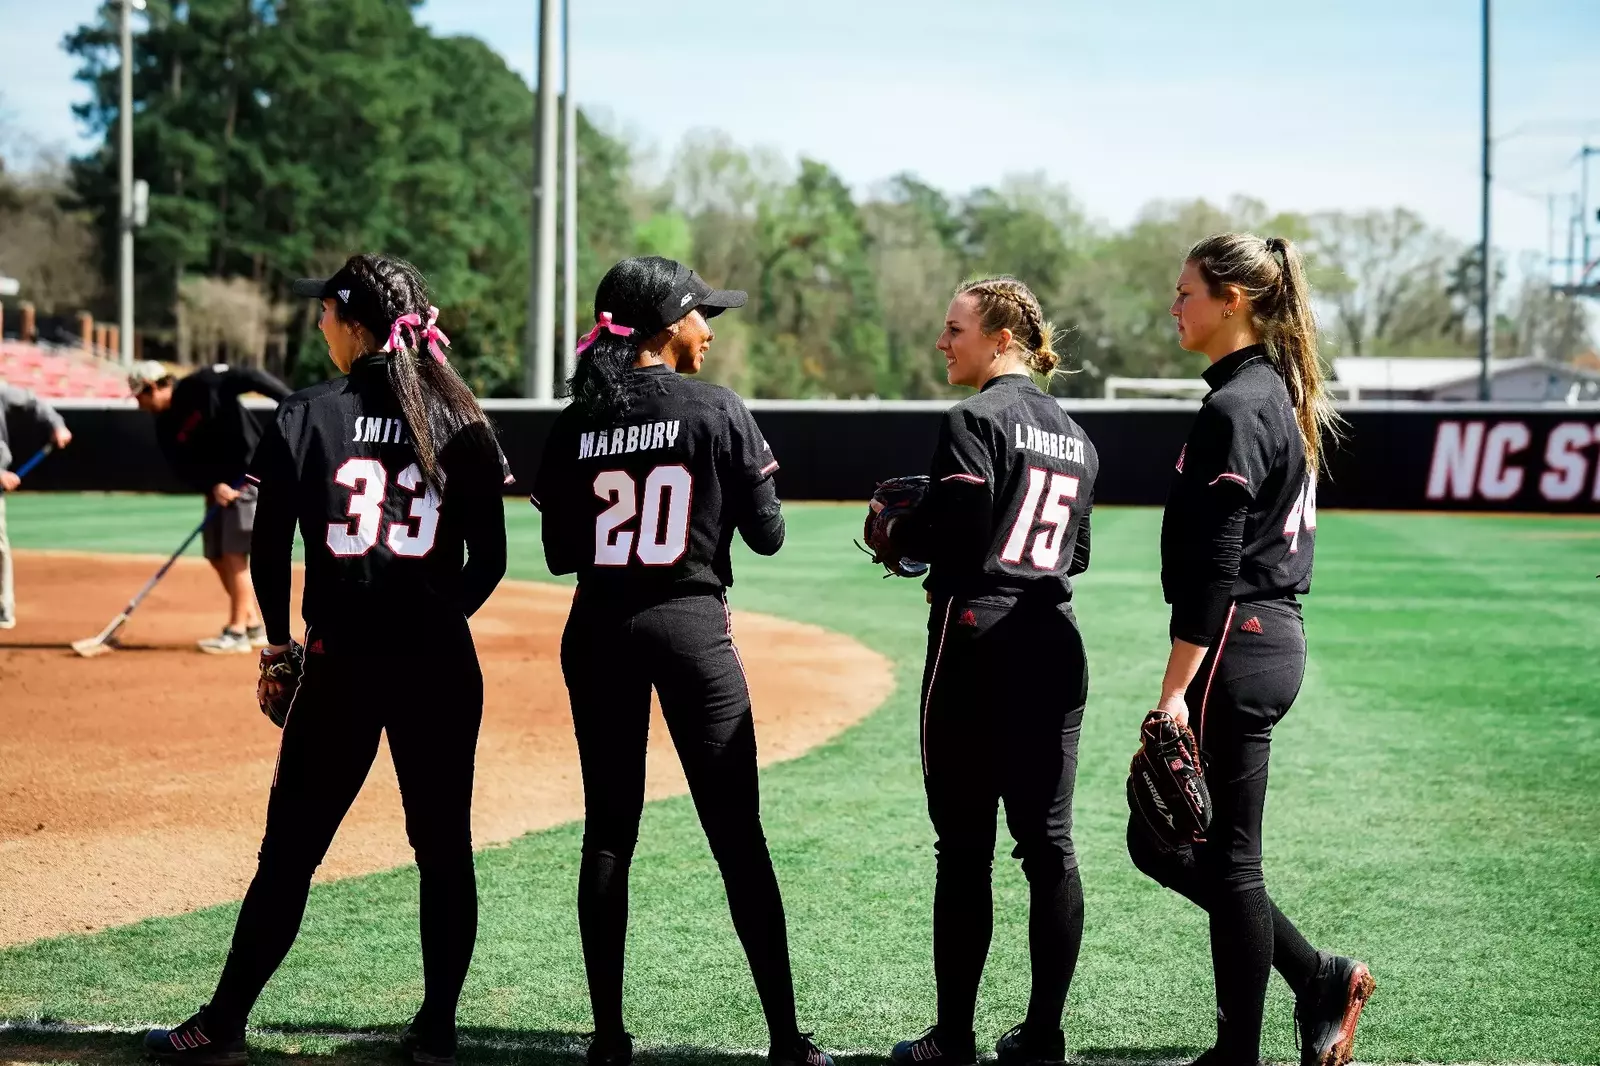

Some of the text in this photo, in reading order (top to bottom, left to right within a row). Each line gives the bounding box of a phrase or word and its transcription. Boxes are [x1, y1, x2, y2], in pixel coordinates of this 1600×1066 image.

[352, 416, 409, 444] SMIT
[578, 420, 680, 460] MARBURY
[1015, 423, 1085, 465] LAMBRECHT
[1426, 420, 1600, 502] NC S
[326, 457, 445, 558] 33
[592, 463, 694, 566] 20
[1000, 465, 1080, 570] 15
